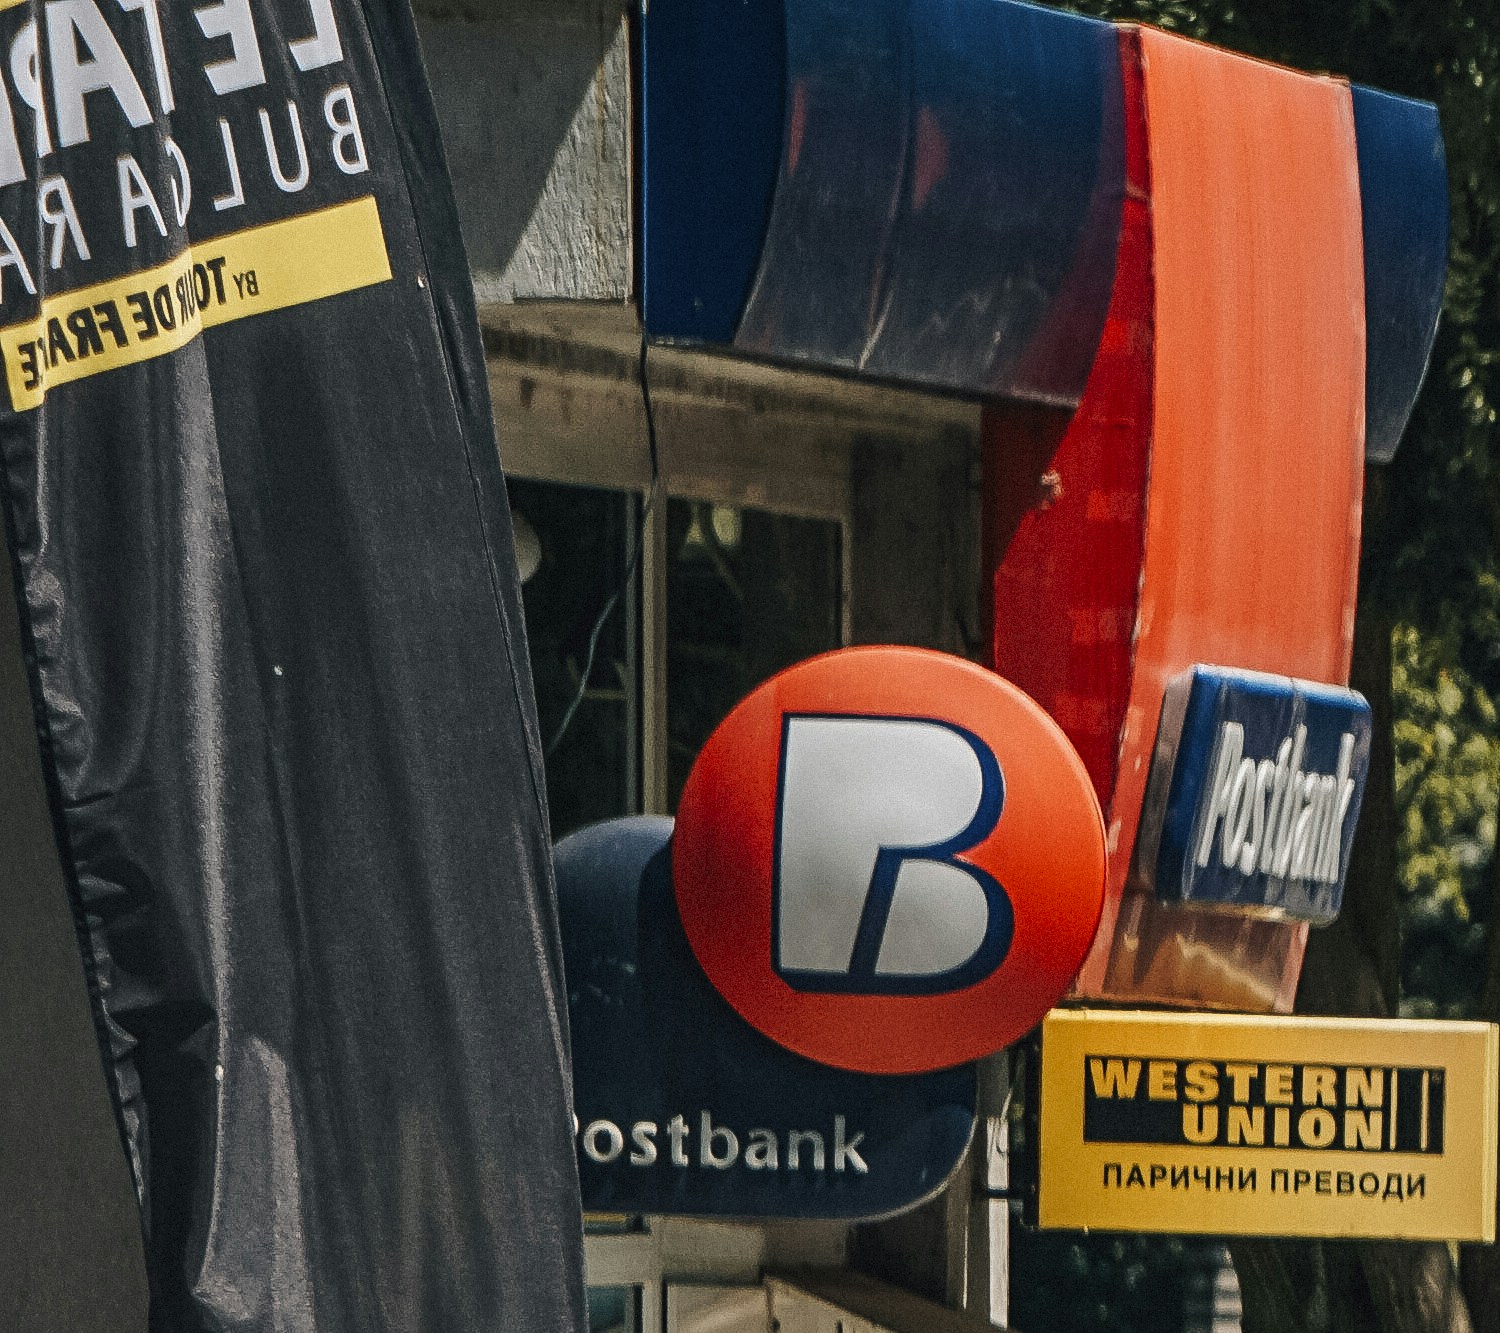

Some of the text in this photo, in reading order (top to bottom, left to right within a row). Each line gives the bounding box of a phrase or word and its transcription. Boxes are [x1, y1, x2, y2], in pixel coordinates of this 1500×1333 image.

[1090, 1058, 1384, 1109] WESTERN
[573, 1109, 869, 1173] ostbank
[1182, 1104, 1384, 1150] UNION
[1102, 1163, 1426, 1201] ПАРИЧНИ ПРЕВОДИ
